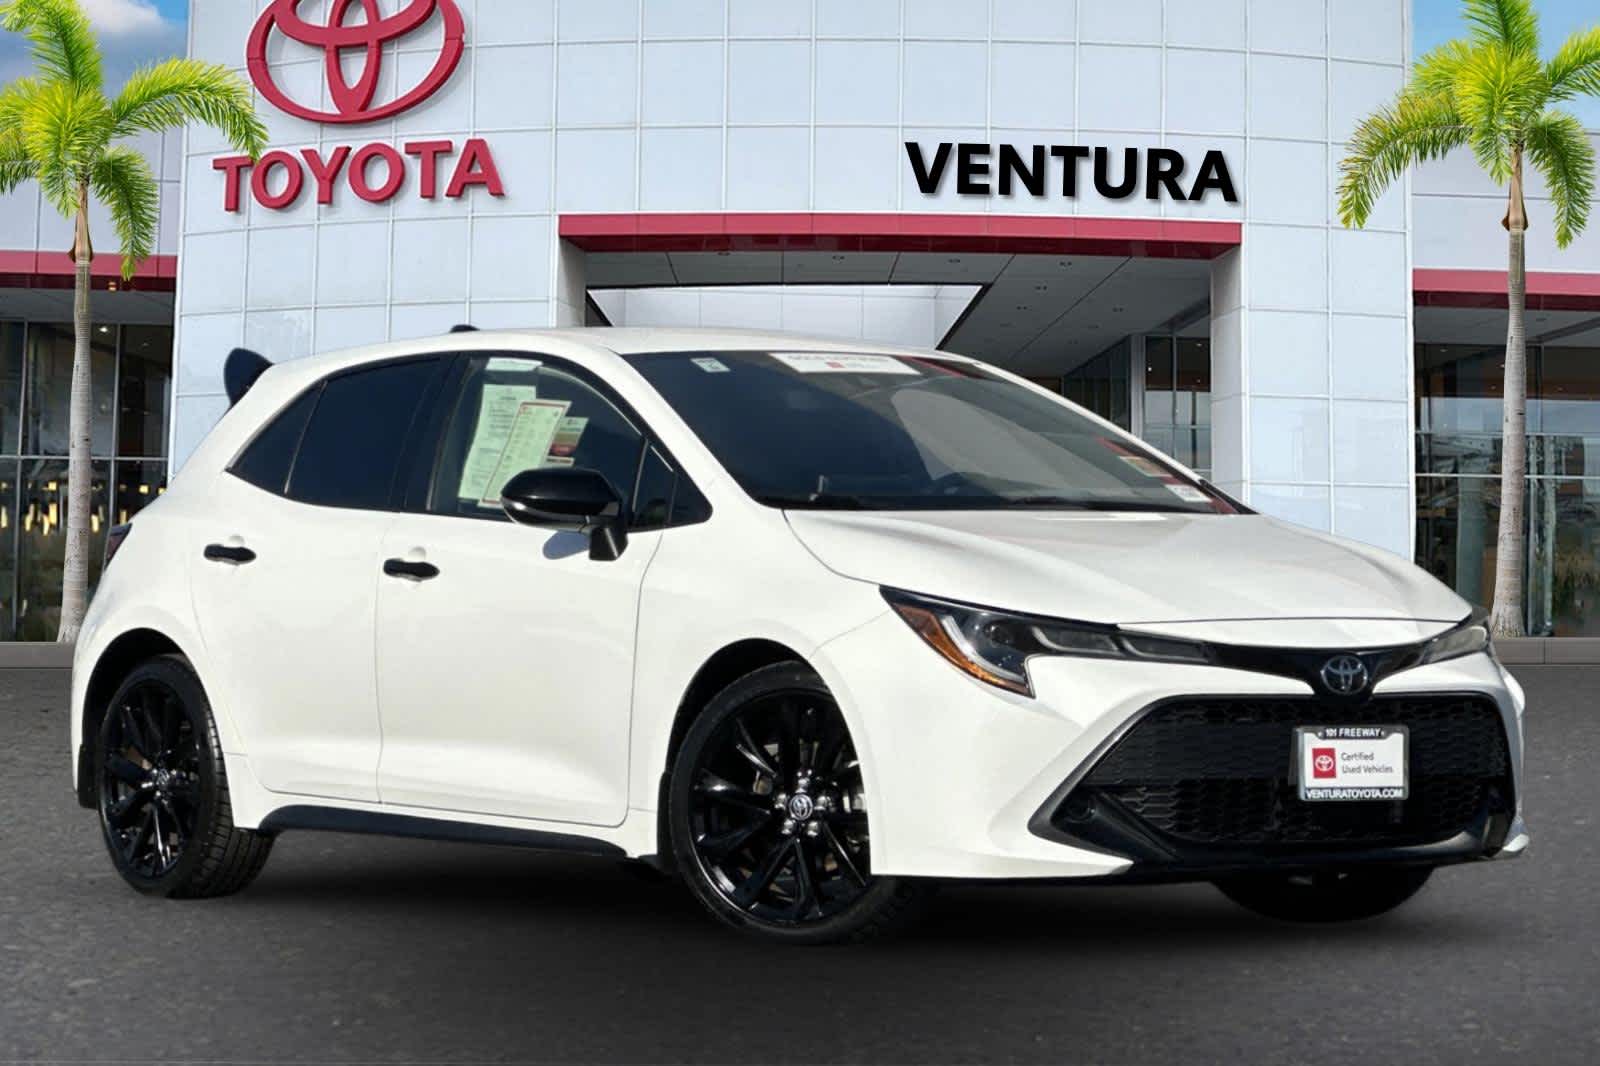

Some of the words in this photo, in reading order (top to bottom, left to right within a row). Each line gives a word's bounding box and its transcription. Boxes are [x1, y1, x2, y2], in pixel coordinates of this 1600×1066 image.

[213, 139, 504, 212] TOYOTA
[905, 142, 1239, 202] VENTURA
[1325, 728, 1337, 737] 101
[1338, 728, 1380, 737] FREEWAY
[1340, 752, 1375, 761] Certified
[1341, 765, 1361, 774] Used
[1362, 765, 1393, 774] Vehicles
[1305, 789, 1404, 799] VENTURATOYOTA.COM
